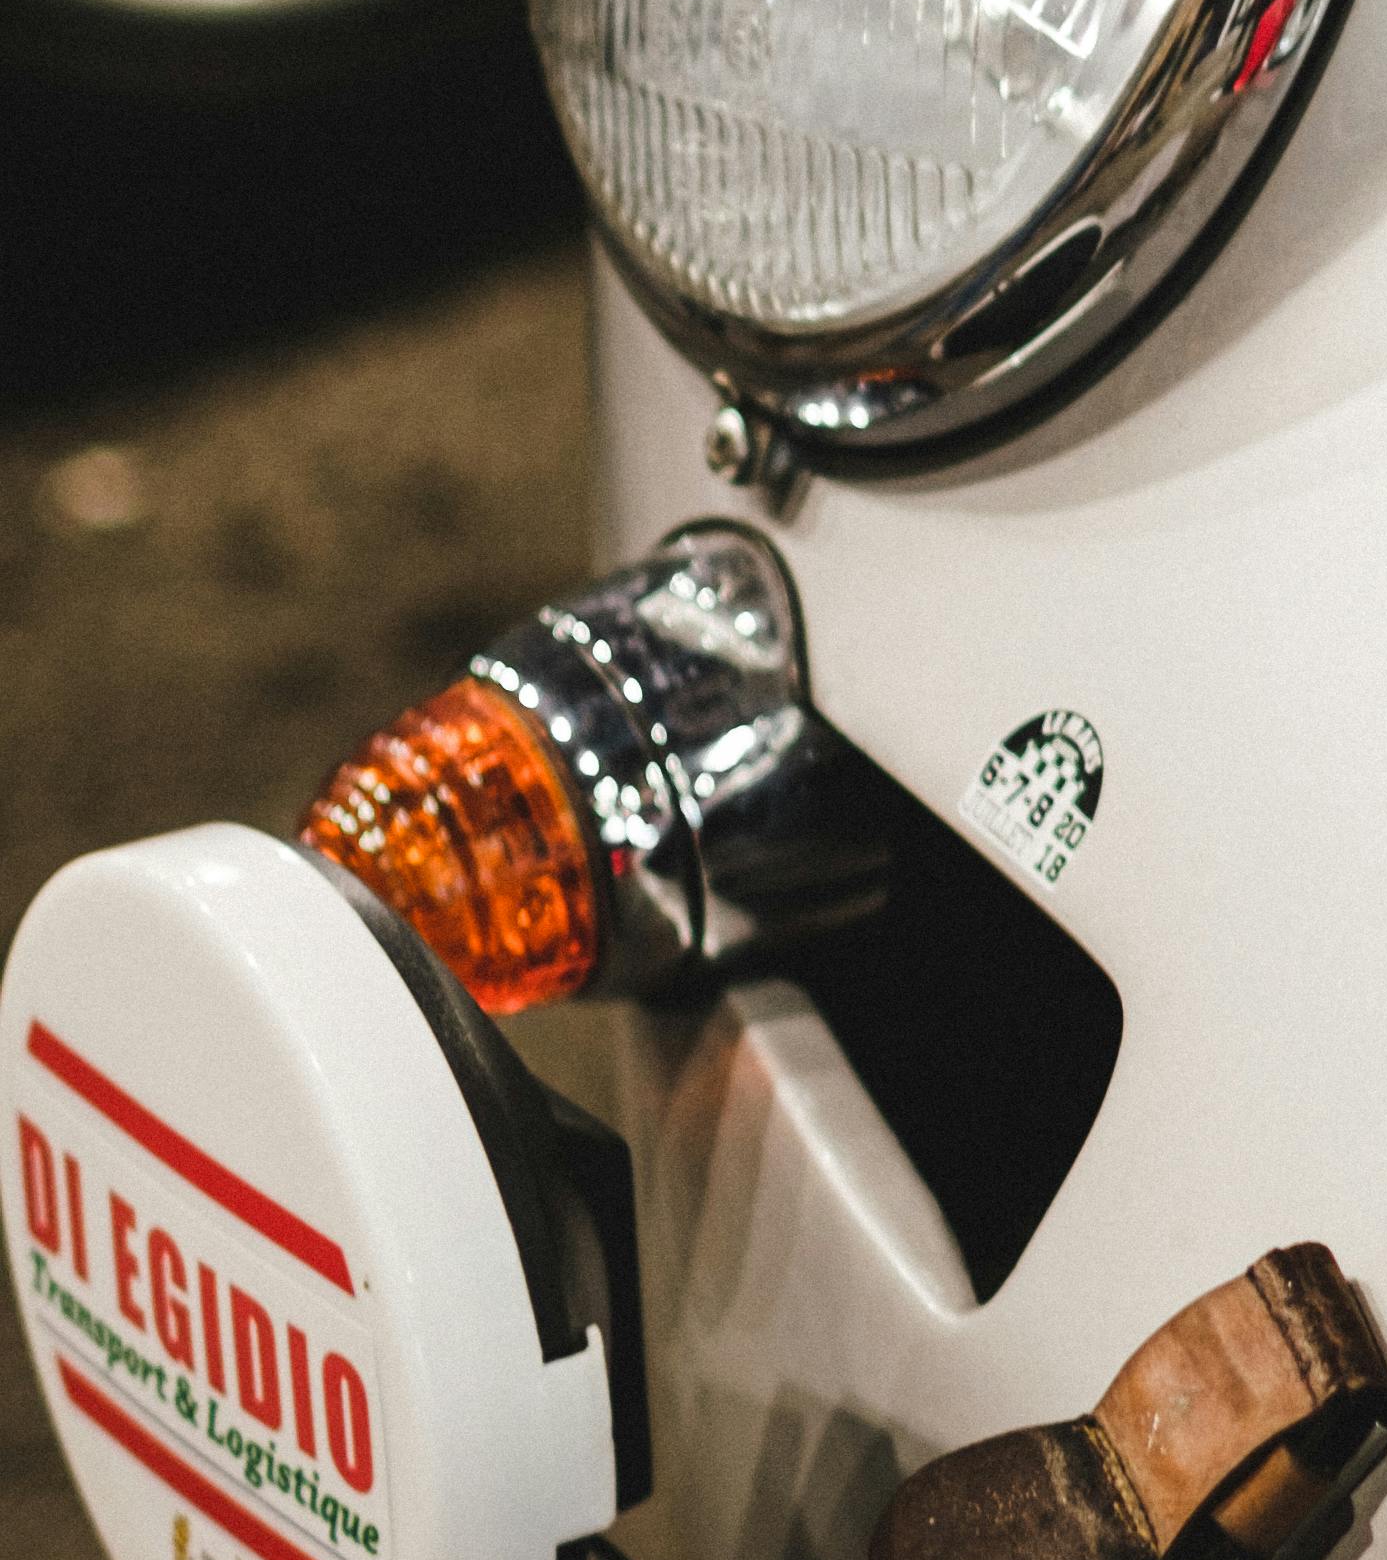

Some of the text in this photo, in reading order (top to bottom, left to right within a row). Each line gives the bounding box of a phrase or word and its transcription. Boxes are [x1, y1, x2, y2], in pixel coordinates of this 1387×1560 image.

[1033, 843, 1067, 883] 18
[1053, 811, 1087, 850] 20
[17, 1109, 374, 1496] DI EGIDIO
[29, 1247, 380, 1556] Transport & Logistique
